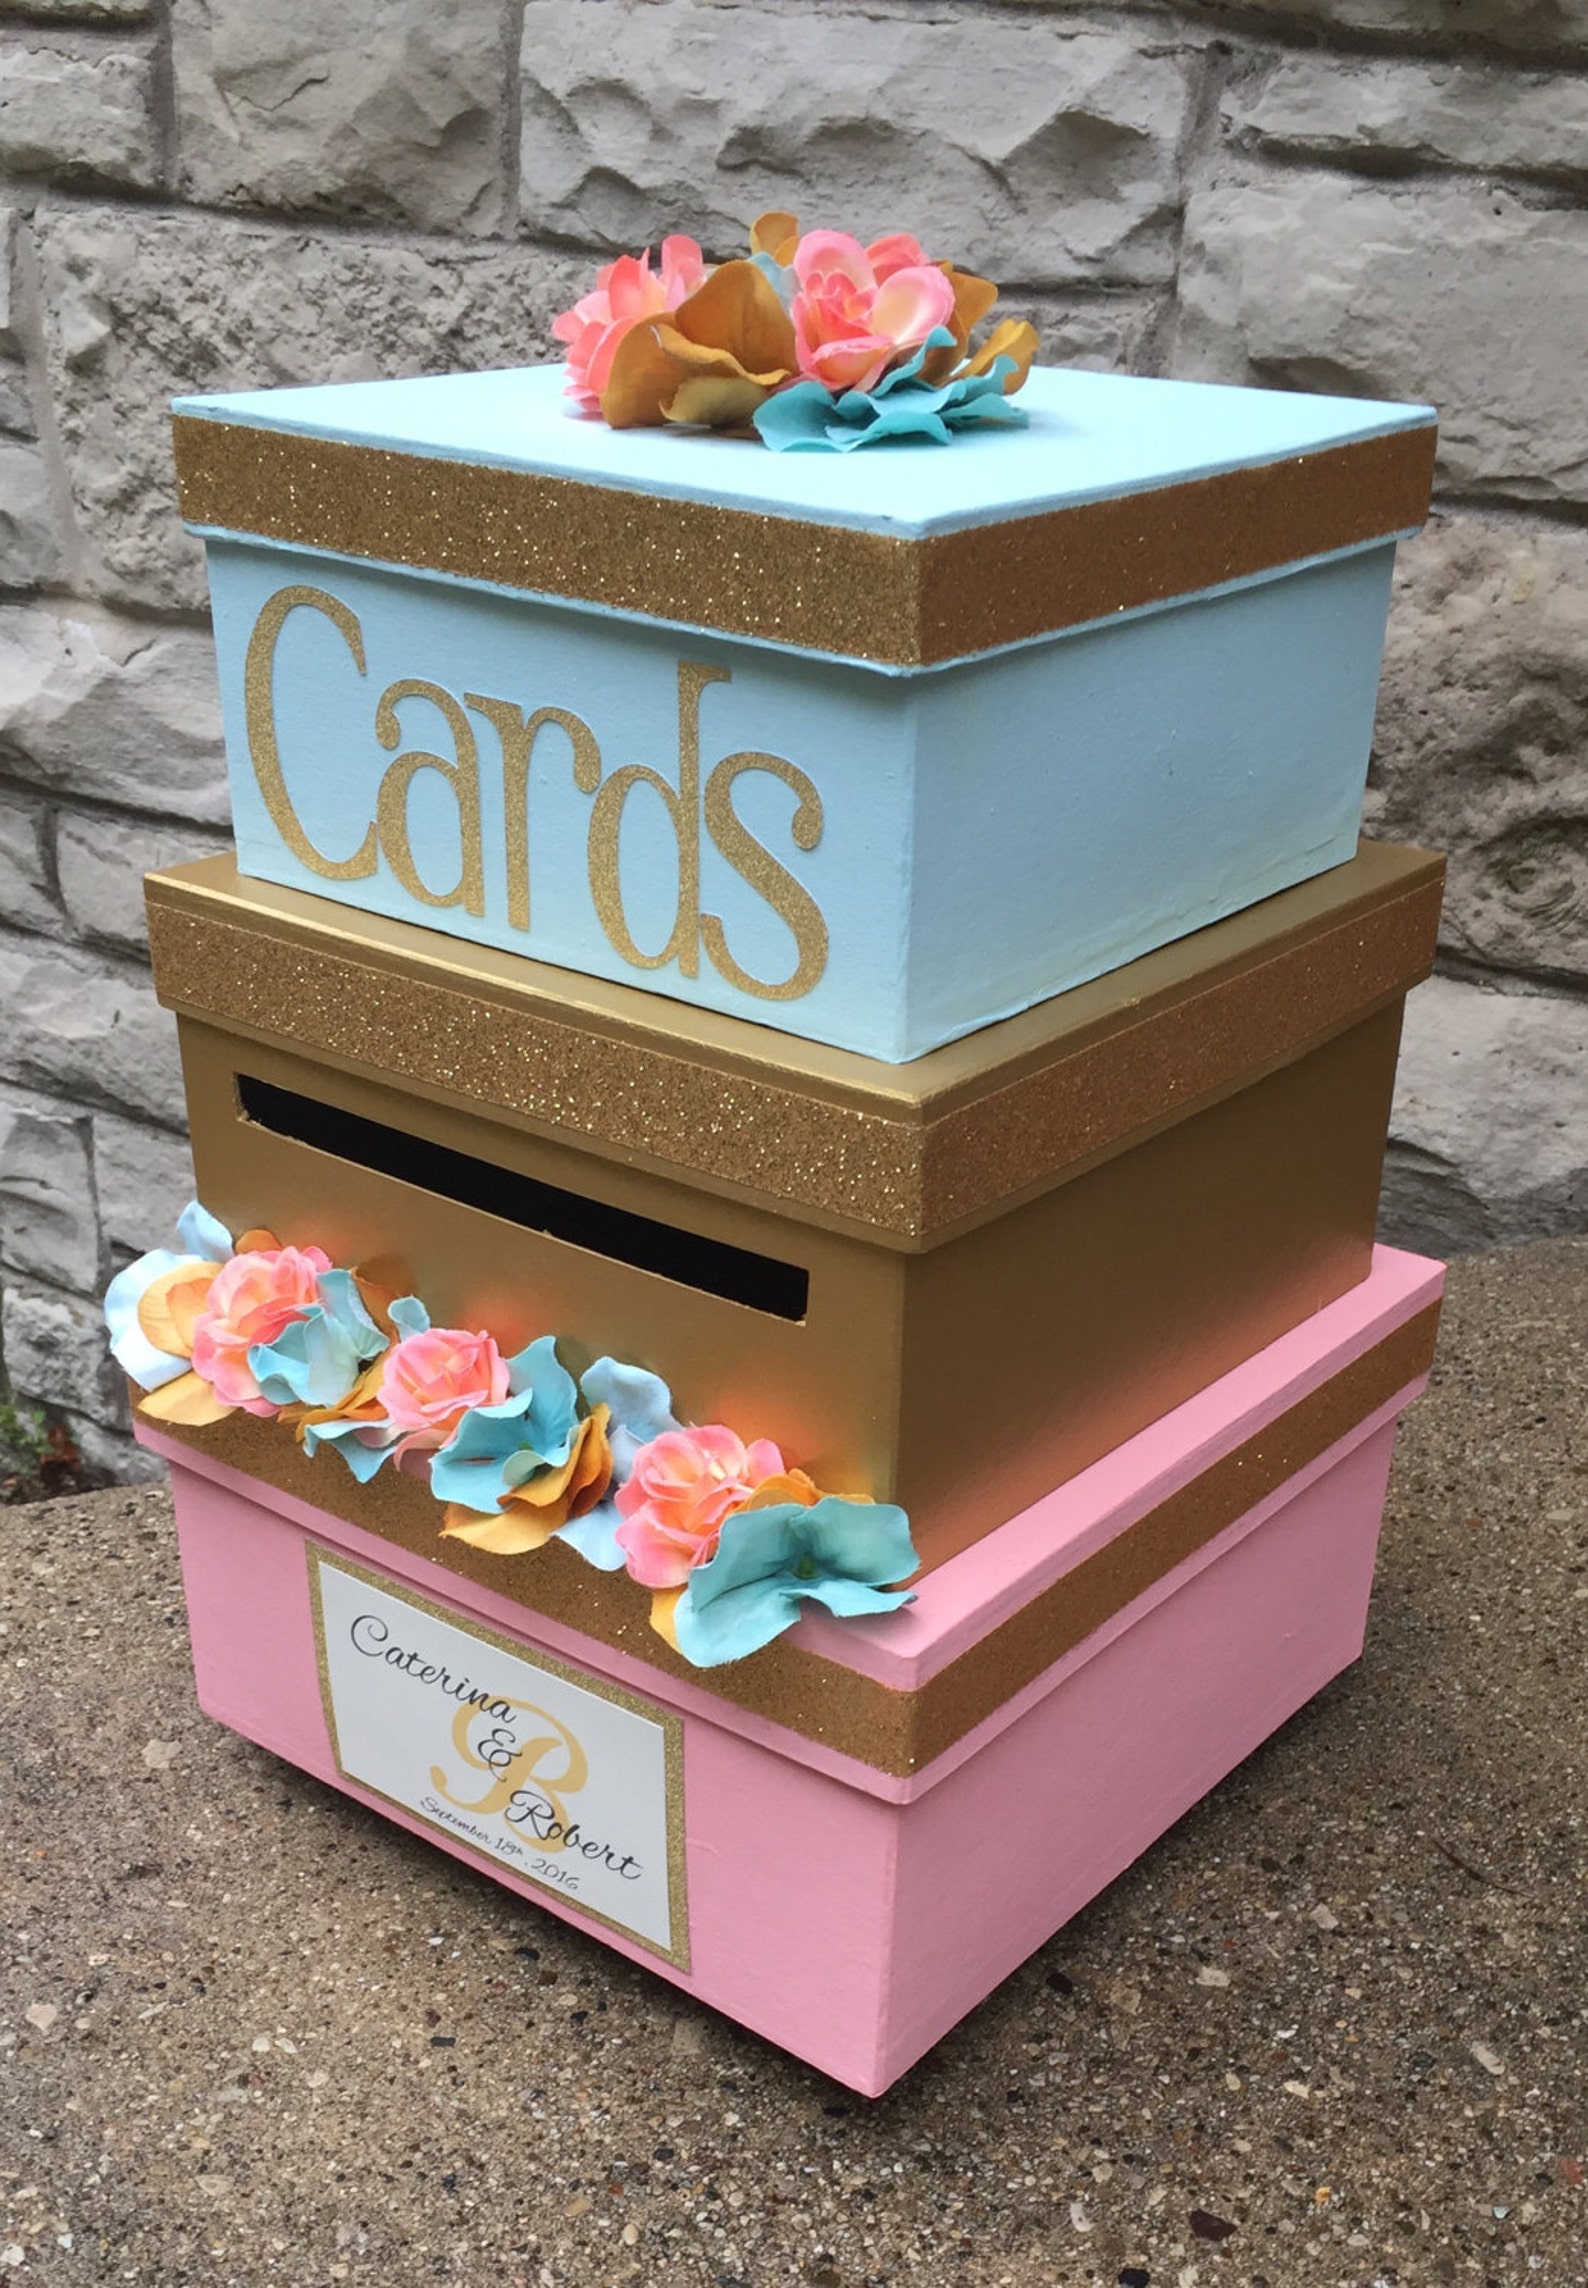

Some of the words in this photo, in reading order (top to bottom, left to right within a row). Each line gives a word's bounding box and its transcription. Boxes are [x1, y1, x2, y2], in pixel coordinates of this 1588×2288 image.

[245, 584, 829, 1001] Cards
[350, 1615, 516, 1724] Caterina
[477, 1729, 522, 1782] &
[504, 1789, 642, 1881] Robert
[532, 1858, 580, 1891] 2016
